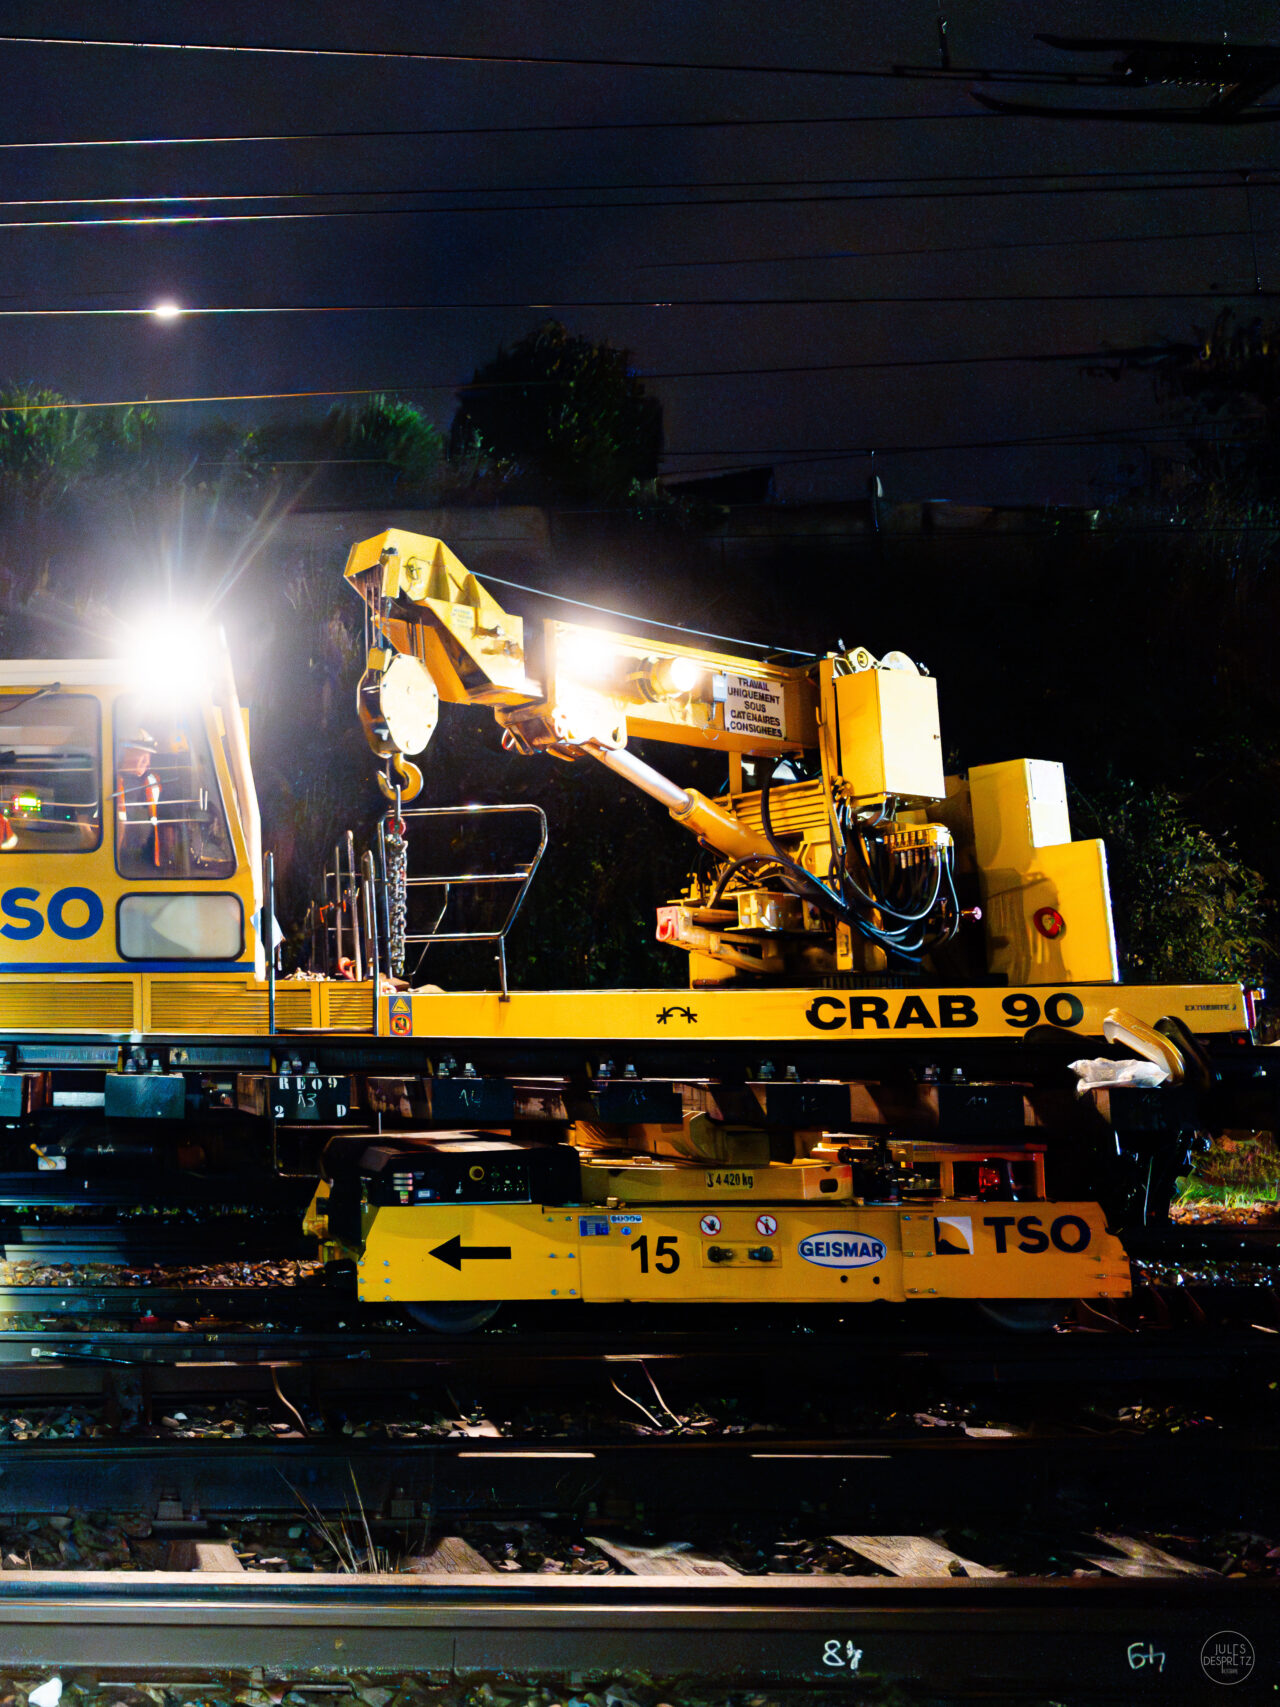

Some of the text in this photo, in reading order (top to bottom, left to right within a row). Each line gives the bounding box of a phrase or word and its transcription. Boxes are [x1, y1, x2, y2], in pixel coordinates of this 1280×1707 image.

[737, 677, 770, 692] TRAVAIL
[727, 686, 781, 705] UNIQUEMENT
[744, 700, 767, 713] SOUS
[730, 709, 781, 727] CATENAIRES
[730, 720, 783, 738] CONSIGNEES
[805, 992, 1084, 1030] CRAB 90
[274, 1105, 285, 1118] 2
[983, 1214, 1092, 1254] TSO
[630, 1234, 681, 1275] 15
[800, 1240, 885, 1259] GEISMAR
